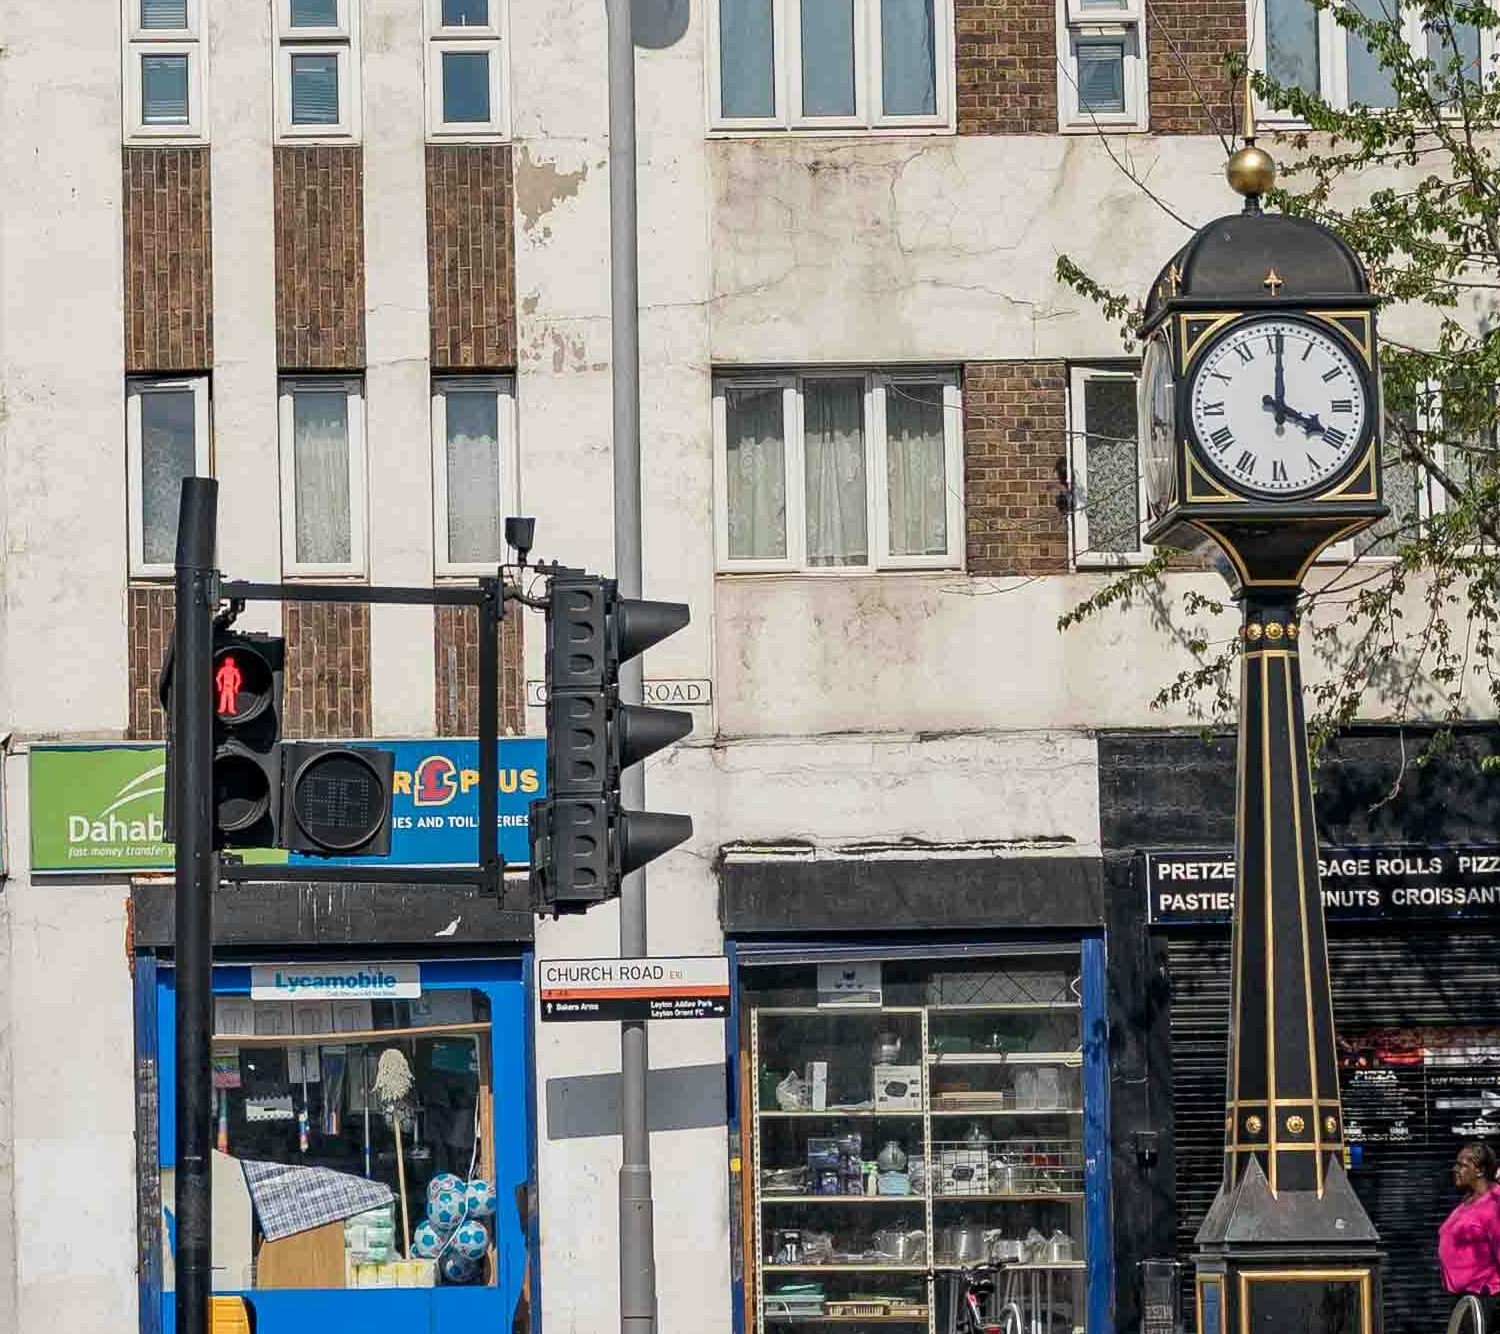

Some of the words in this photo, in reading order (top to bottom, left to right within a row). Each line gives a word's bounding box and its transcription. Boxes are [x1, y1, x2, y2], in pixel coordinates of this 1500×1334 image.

[460, 769, 539, 794] PUS
[68, 812, 165, 843] Dahab
[417, 817, 444, 828] AND
[448, 815, 529, 828] TOILERIES
[69, 846, 88, 859] fast
[91, 847, 123, 858] money
[126, 845, 163, 858] transfer
[1158, 862, 1235, 881] PRETZE
[1317, 859, 1370, 877] SAGE
[1376, 857, 1442, 875] ROLLS
[275, 970, 397, 993] Lycamobile
[546, 966, 613, 982] CHURCH
[619, 964, 664, 980] ROAD
[694, 1008, 704, 1016] FC
[1354, 1069, 1398, 1080] PIZZA
